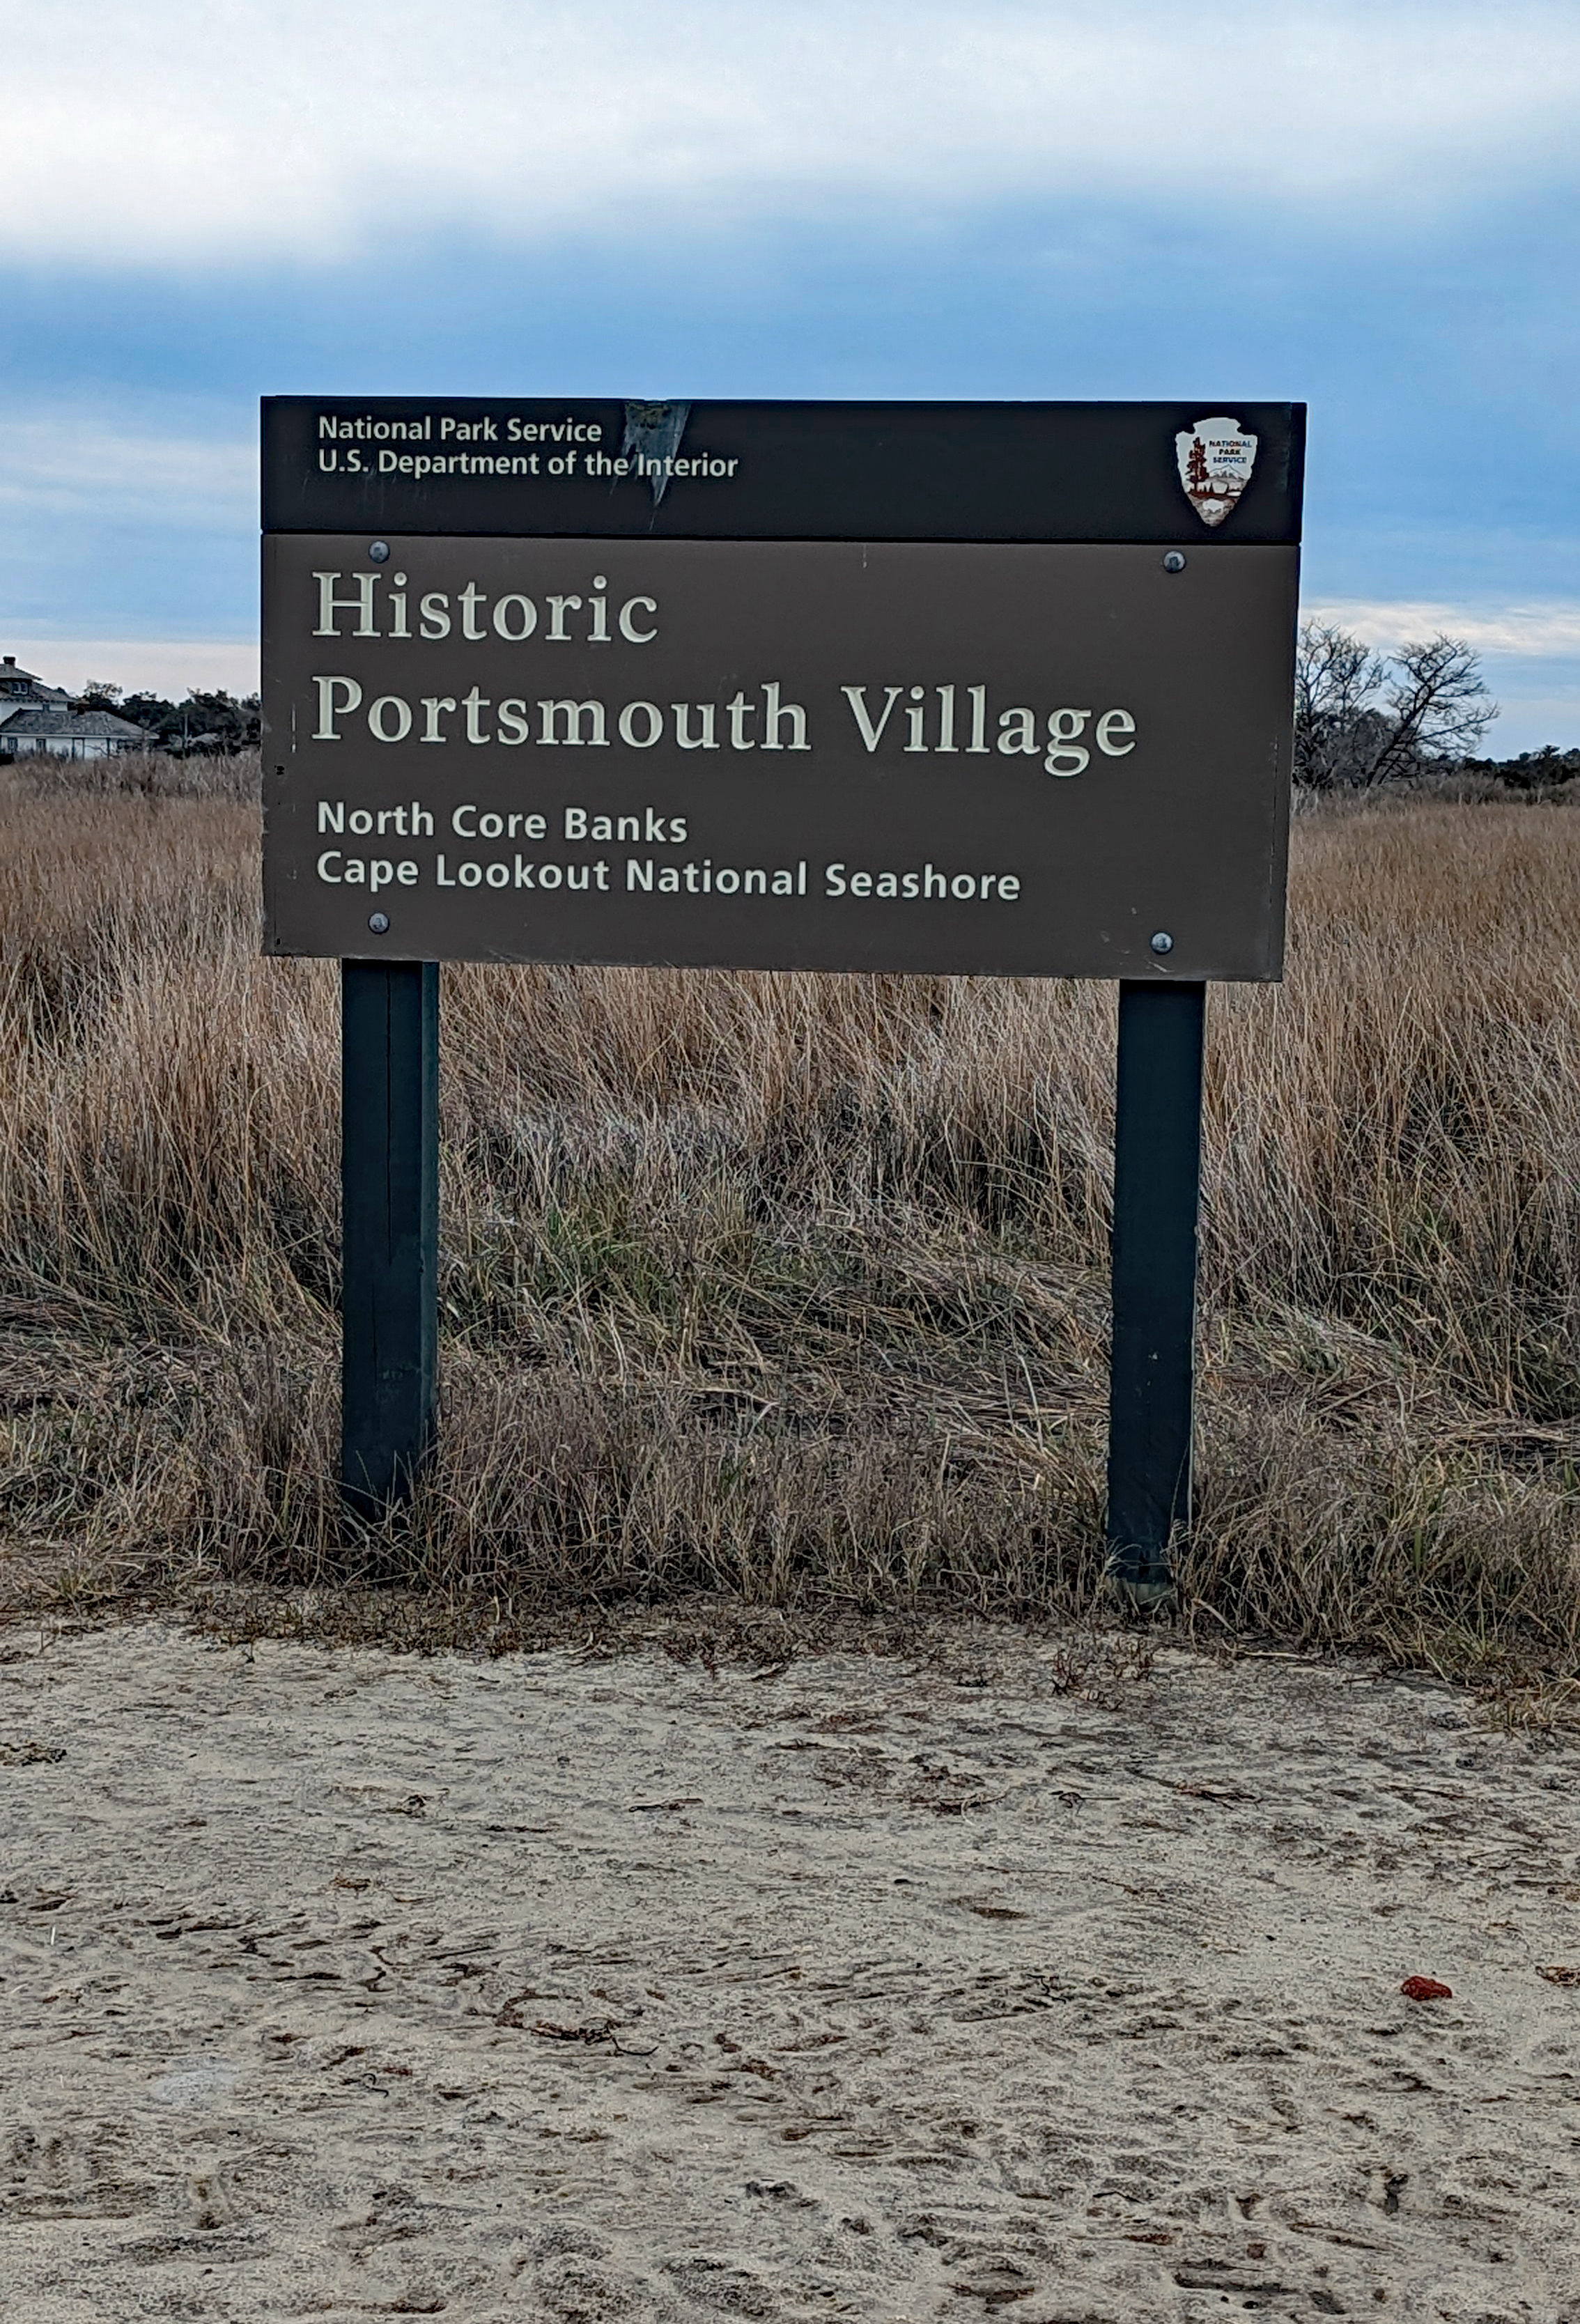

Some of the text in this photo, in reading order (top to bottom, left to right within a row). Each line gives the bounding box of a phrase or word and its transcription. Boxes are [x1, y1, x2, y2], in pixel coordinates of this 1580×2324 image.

[319, 416, 602, 442] National Park Service
[1209, 440, 1252, 448] NATIONAL
[319, 449, 738, 479] U.S. Department of the Interior
[312, 571, 658, 643] Historic
[311, 676, 1136, 777] Portsmouth Village
[318, 801, 687, 843] North Core Banks
[317, 851, 1020, 900] Cape Lookout National Seashore
